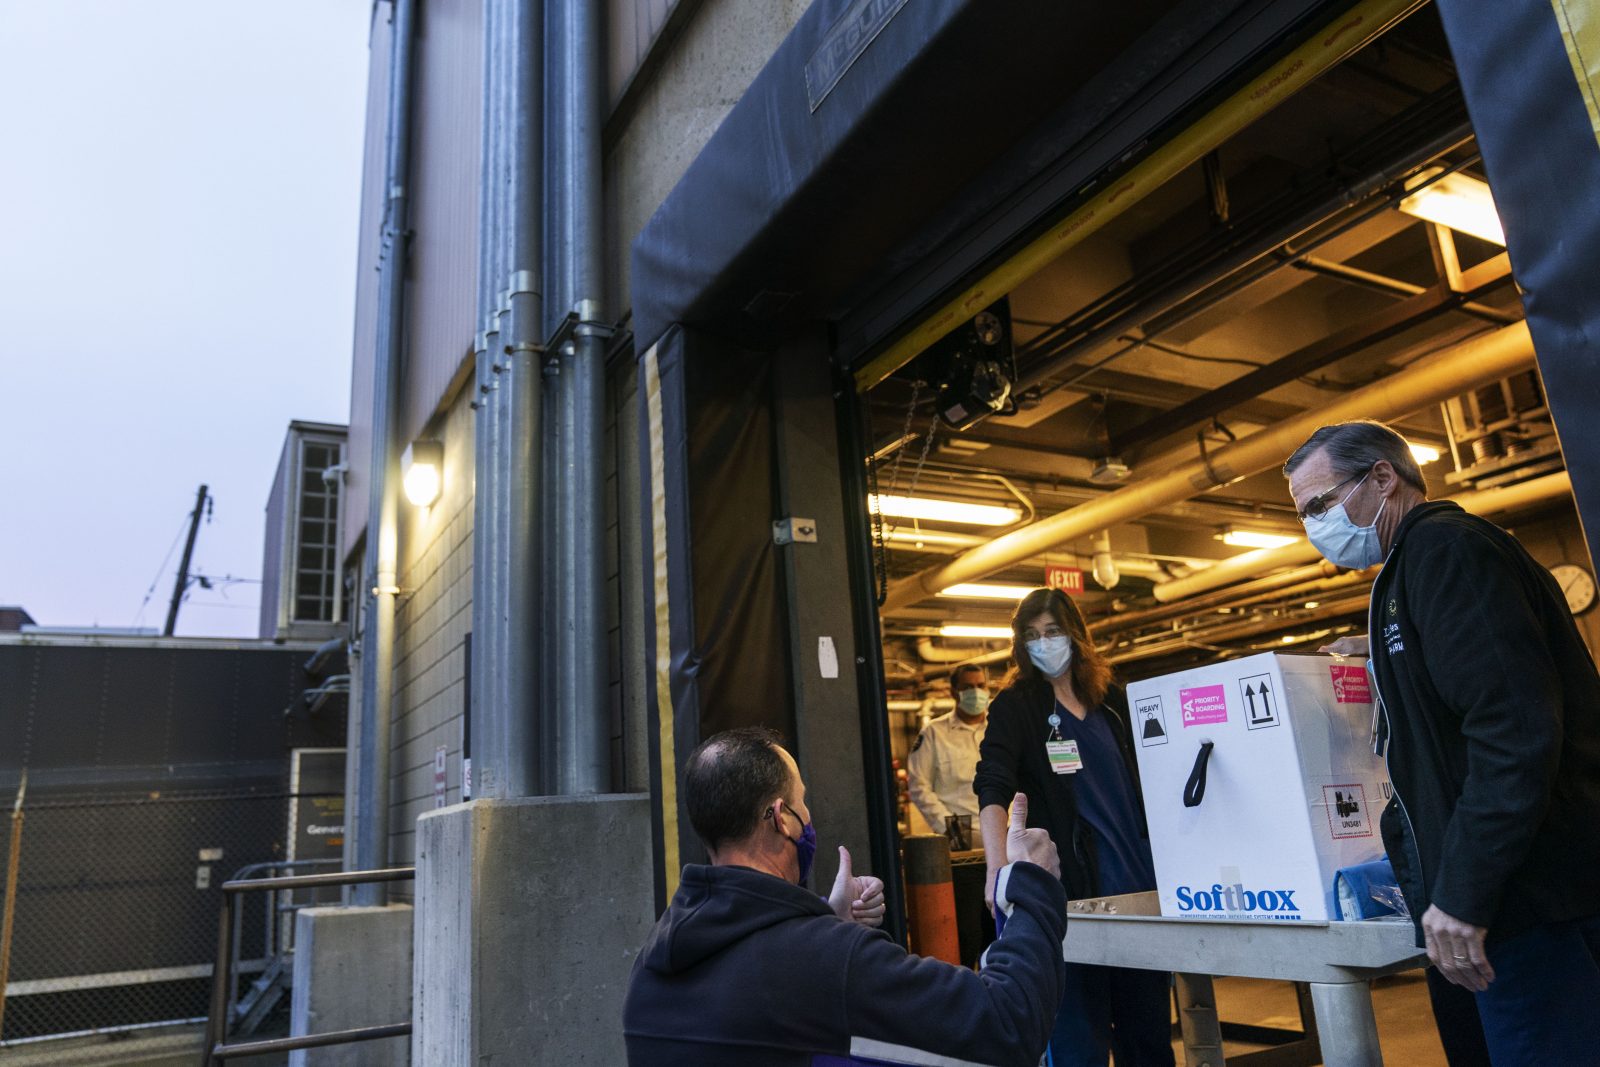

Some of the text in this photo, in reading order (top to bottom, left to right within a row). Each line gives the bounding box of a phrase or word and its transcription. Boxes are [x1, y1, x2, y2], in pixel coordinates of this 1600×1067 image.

[816, 0, 893, 87] McGUI
[1055, 570, 1080, 589] EXIT
[1333, 677, 1346, 698] PA
[1139, 703, 1160, 713] HEAVY
[1194, 696, 1220, 704] PRIORITY
[1195, 703, 1225, 712] BOARDING
[1183, 699, 1196, 721] PA
[1341, 820, 1362, 828] UN3481
[1176, 883, 1300, 911] Softbox
